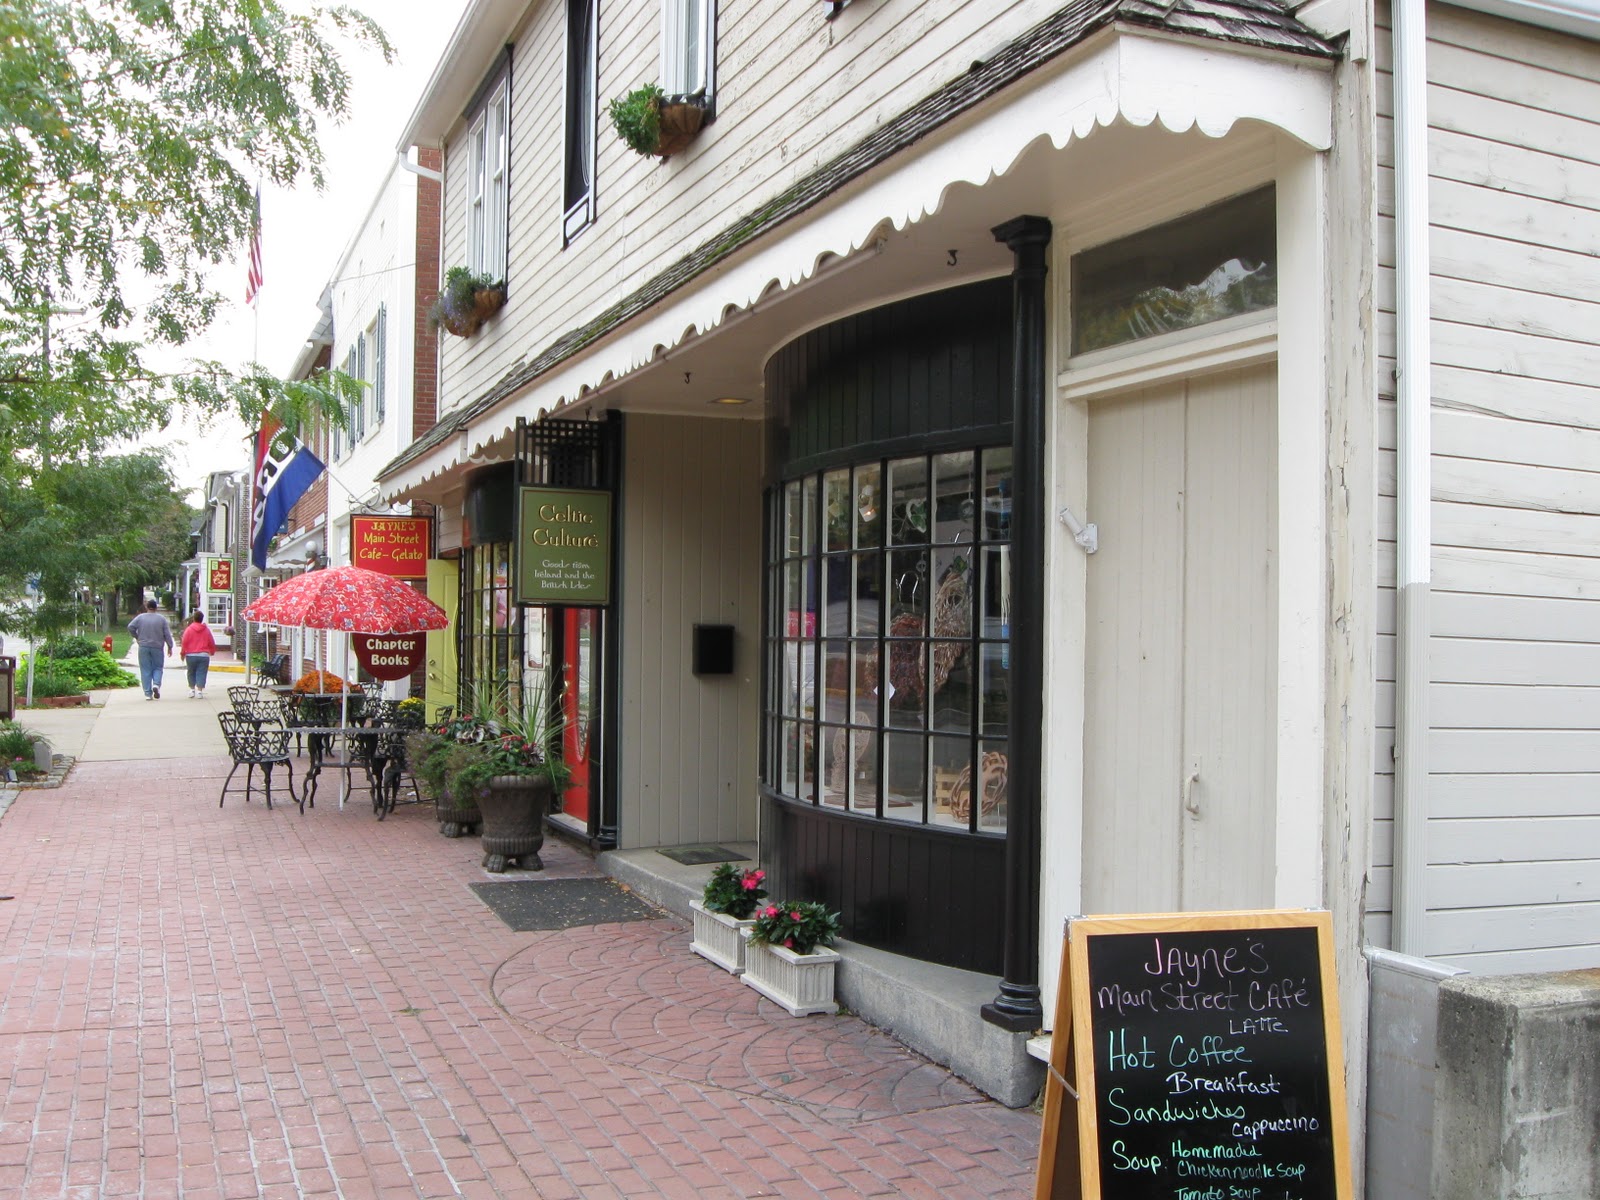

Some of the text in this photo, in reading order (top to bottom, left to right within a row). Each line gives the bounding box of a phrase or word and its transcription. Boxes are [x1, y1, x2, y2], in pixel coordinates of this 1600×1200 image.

[539, 504, 593, 524] Celtic
[363, 532, 419, 545] Main Street
[533, 528, 598, 547] Culture
[391, 548, 423, 562] Gelato
[534, 569, 595, 579] Ireland and the
[541, 580, 591, 589] British Isles
[366, 638, 416, 650] Chapter
[371, 654, 410, 666] Books
[1098, 983, 1158, 1016] Main
[1160, 979, 1239, 1012] Street
[1109, 1028, 1252, 1072] Hot Coffee
[1166, 1071, 1280, 1095] Breakfast
[1108, 1087, 1246, 1126] Sandwiches
